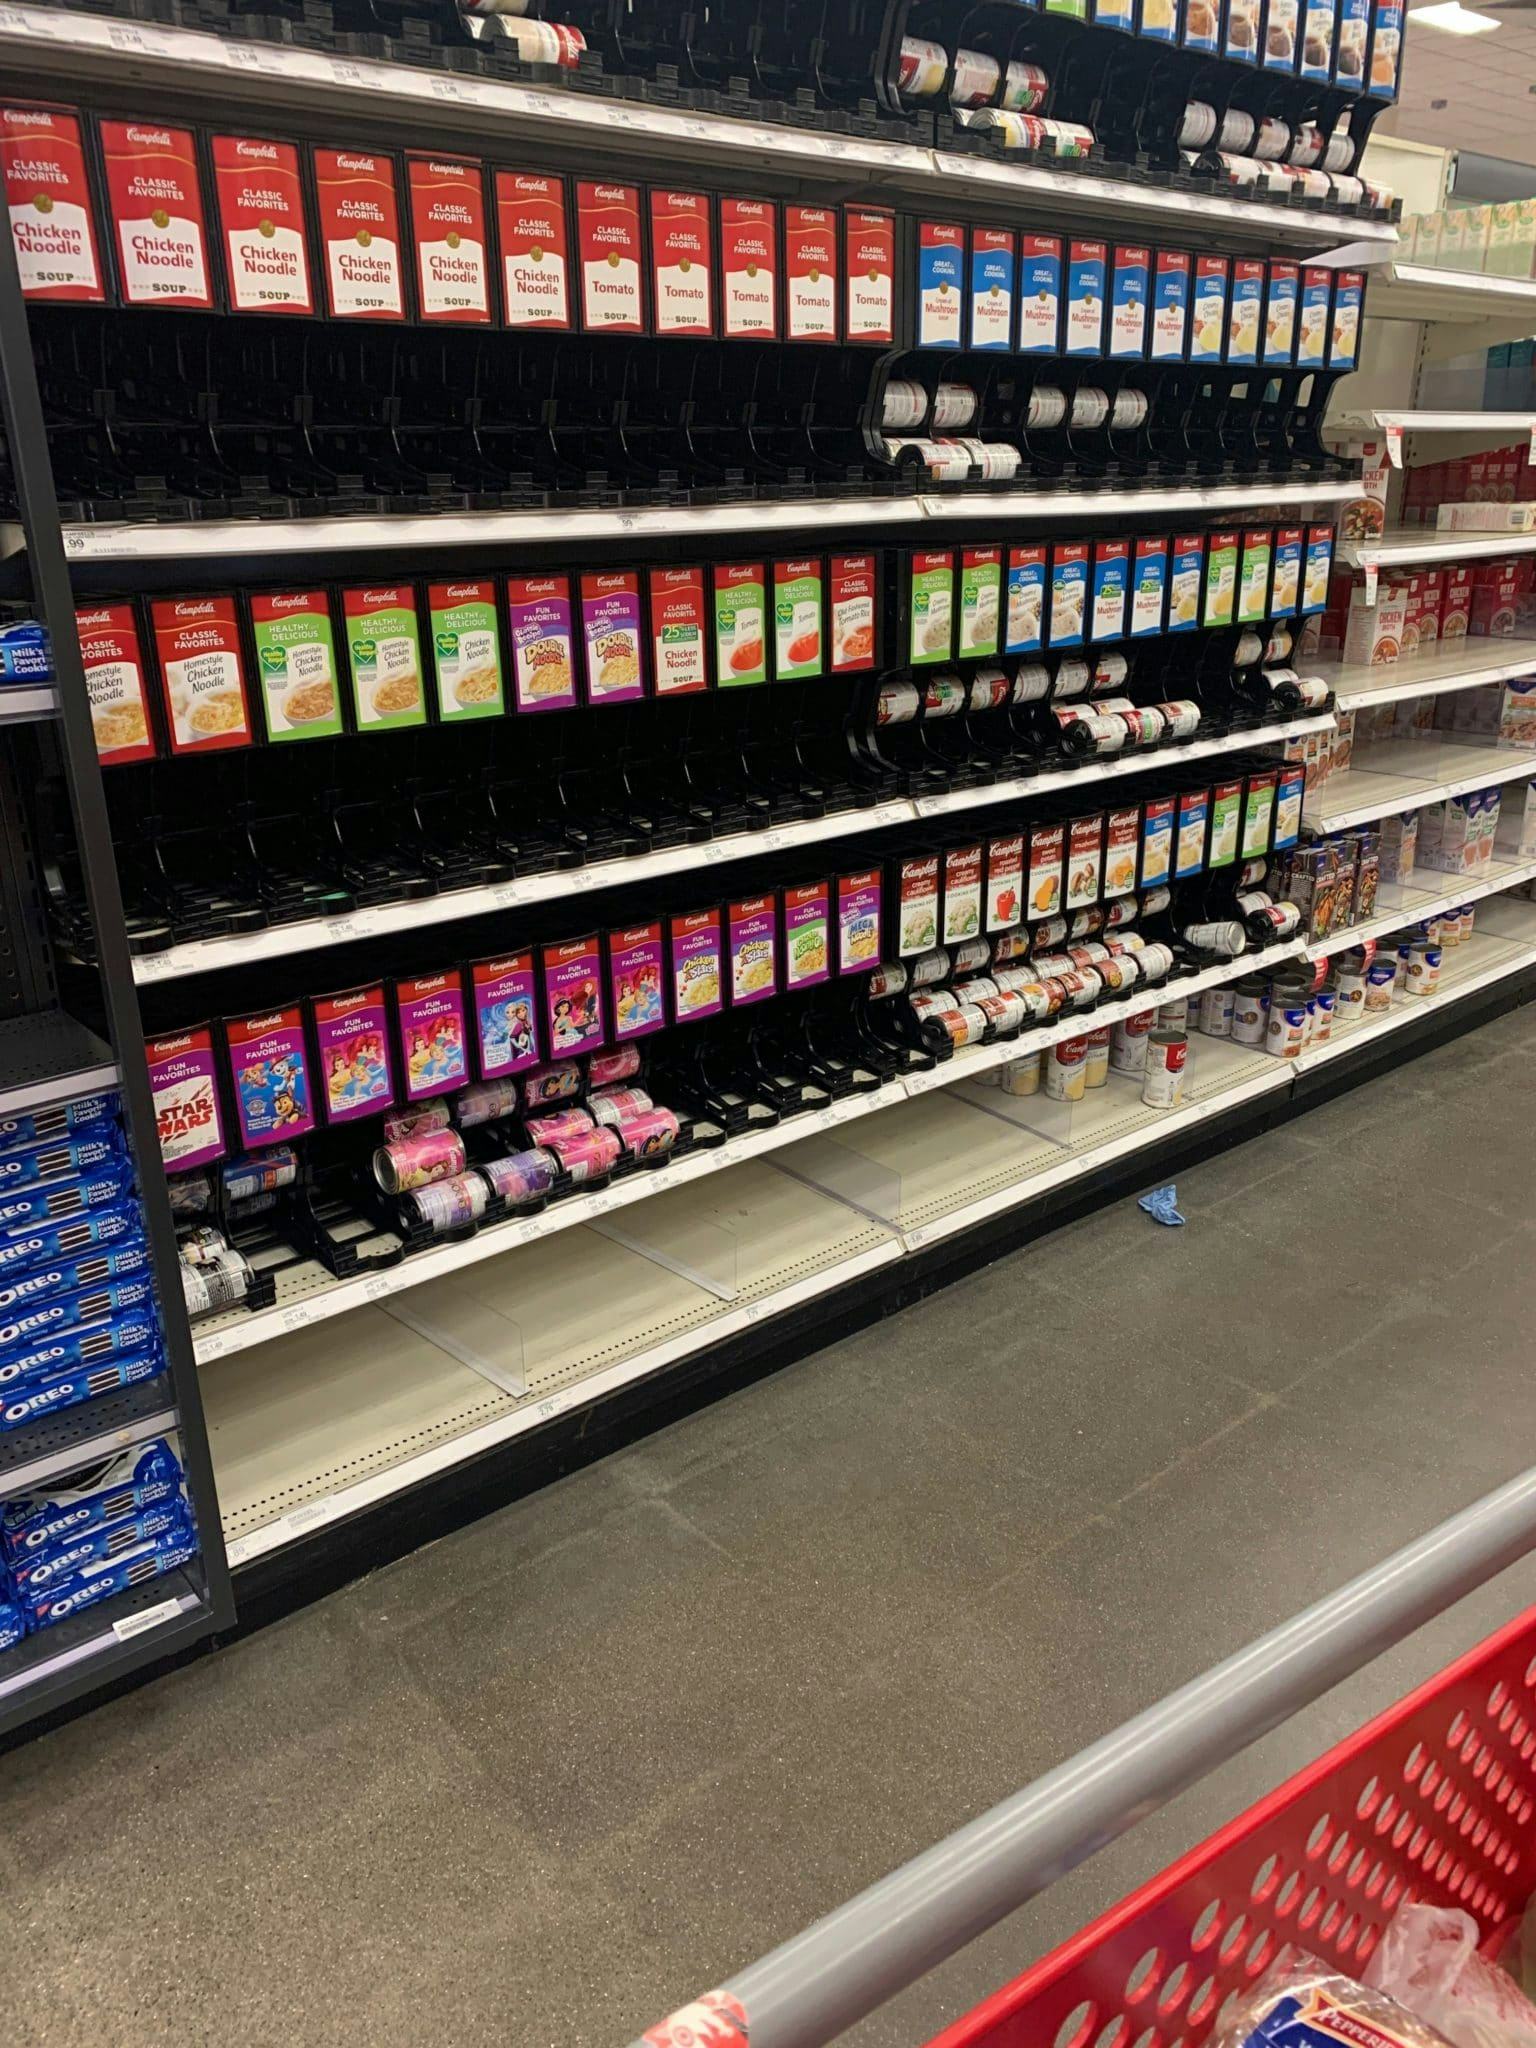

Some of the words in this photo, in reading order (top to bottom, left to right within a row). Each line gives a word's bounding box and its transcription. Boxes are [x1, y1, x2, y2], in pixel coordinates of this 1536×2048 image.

[13, 160, 60, 173] CLASSIC
[7, 169, 69, 183] FAVORITES
[134, 177, 177, 190] CLASSIC
[128, 186, 184, 200] FAVORITES
[243, 189, 282, 200] CLASSIC
[237, 198, 288, 211] FAVORITES
[342, 200, 378, 212] CLASSIC
[433, 204, 467, 215] CLASSIC
[337, 209, 384, 221] FAVORITES
[429, 212, 472, 224] FAVORITES
[518, 219, 550, 229] CLASSIC
[13, 223, 81, 240] Chicken
[514, 227, 555, 238] FAVORITES
[597, 226, 626, 236] CLASSIC
[592, 233, 631, 244] FAVORITES
[670, 233, 697, 242] CLASSIC
[738, 239, 763, 248] CLASSIC
[19, 238, 81, 254] Noodle
[132, 236, 194, 254] Chicken
[665, 240, 701, 250] FAVORITES
[734, 246, 767, 256] FAVORITES
[801, 245, 826, 254] CLASSIC
[861, 246, 884, 254] CLASSIC
[137, 252, 193, 268] Noodle
[240, 246, 297, 262] Chicken
[797, 252, 829, 262] FAVORITES
[857, 252, 887, 262] FAVORITES
[245, 260, 296, 276] Noodle
[338, 255, 391, 271] Chicken
[429, 256, 478, 271] Chicken
[37, 272, 74, 281] SOUP
[342, 269, 390, 284] Noodle
[433, 270, 477, 284] Noodle
[514, 269, 559, 283] Chicken
[152, 283, 186, 293] SOUP
[517, 282, 558, 295] Noodle
[592, 281, 634, 295] Tomato
[665, 285, 704, 299] Tomato
[259, 291, 290, 300] SOUP
[444, 297, 471, 306] SOUP
[732, 290, 769, 303] Tomato
[796, 295, 830, 308] Tomato
[855, 294, 887, 306] Tomato
[355, 298, 384, 307] SOUP
[604, 312, 627, 320] SOUP
[742, 319, 763, 327] SOUP
[784, 586, 809, 594] HEALTHY
[840, 585, 868, 593] FAVORITES
[844, 580, 865, 588] CLASSIC
[727, 597, 757, 605] DELICIOUS
[536, 607, 550, 615] FUN
[595, 607, 630, 616] FAVORITES
[663, 610, 696, 618] FAVORITES
[667, 604, 692, 612] CLASSIC
[444, 612, 479, 620] HEALTHY
[524, 613, 561, 622] FAVORITES
[269, 624, 308, 633] HEALTHY
[361, 618, 398, 627] HEALTHY
[446, 618, 486, 628] DELICIOUS
[741, 618, 759, 630] Tomato
[179, 630, 217, 641] CLASSIC
[272, 631, 318, 641] DELICIOUS
[363, 625, 405, 635] DELICIOUS
[81, 640, 115, 650] LASSIC
[174, 638, 224, 649] FAVORITES
[382, 640, 409, 651] Homestyle
[465, 638, 490, 651] Chicken
[596, 632, 633, 657] DOUBLE
[82, 648, 123, 659] VORITES
[292, 646, 322, 658] Homestyle
[384, 648, 409, 661] Chicken
[466, 648, 489, 661] Noodle
[525, 639, 564, 664] DOUBLE
[665, 651, 698, 660] Chicken
[13, 656, 46, 666] Favori
[184, 655, 223, 671] Homestyle
[295, 654, 322, 668] Chicken
[387, 657, 410, 670] Noodle
[667, 659, 696, 668] Noodle
[85, 665, 121, 678] omestyle
[187, 665, 224, 682] Chicken
[299, 664, 323, 678] Noodle
[673, 675, 693, 683] SOUP
[192, 677, 225, 694] Noodle
[794, 909, 822, 922] FAVORITES
[739, 923, 768, 935] FAVORITES
[683, 938, 712, 950] FAVORITES
[693, 935, 704, 943] FUN
[632, 951, 644, 959] FUN
[739, 941, 769, 958] Chicken
[621, 953, 654, 966] FAVORITES
[682, 954, 715, 973] Chicken
[557, 968, 591, 981] FAVORITES
[568, 965, 581, 973] FUN
[488, 984, 524, 998] FAVORITES
[500, 981, 514, 990] FUN
[413, 1003, 452, 1018] FAVORITES
[425, 1000, 441, 1009] FUN
[345, 1018, 360, 1027] FUN
[331, 1021, 373, 1037] FAVORITES
[260, 1040, 278, 1049] FUN
[246, 1043, 291, 1059] FAVORITES
[168, 1062, 186, 1072] FUN
[153, 1065, 200, 1082] FAVORITES
[158, 1099, 212, 1120] STAR
[157, 1110, 212, 1136] WARS
[0, 1271, 62, 1307] OREO
[0, 1306, 64, 1344] OREO
[0, 1346, 65, 1383] OREO
[5, 1383, 74, 1421] OREO
[25, 1508, 90, 1547] OREO
[30, 1543, 94, 1583] OREO
[50, 1577, 113, 1617] OREO
[1317, 2006, 1395, 2048] PEPPERI
